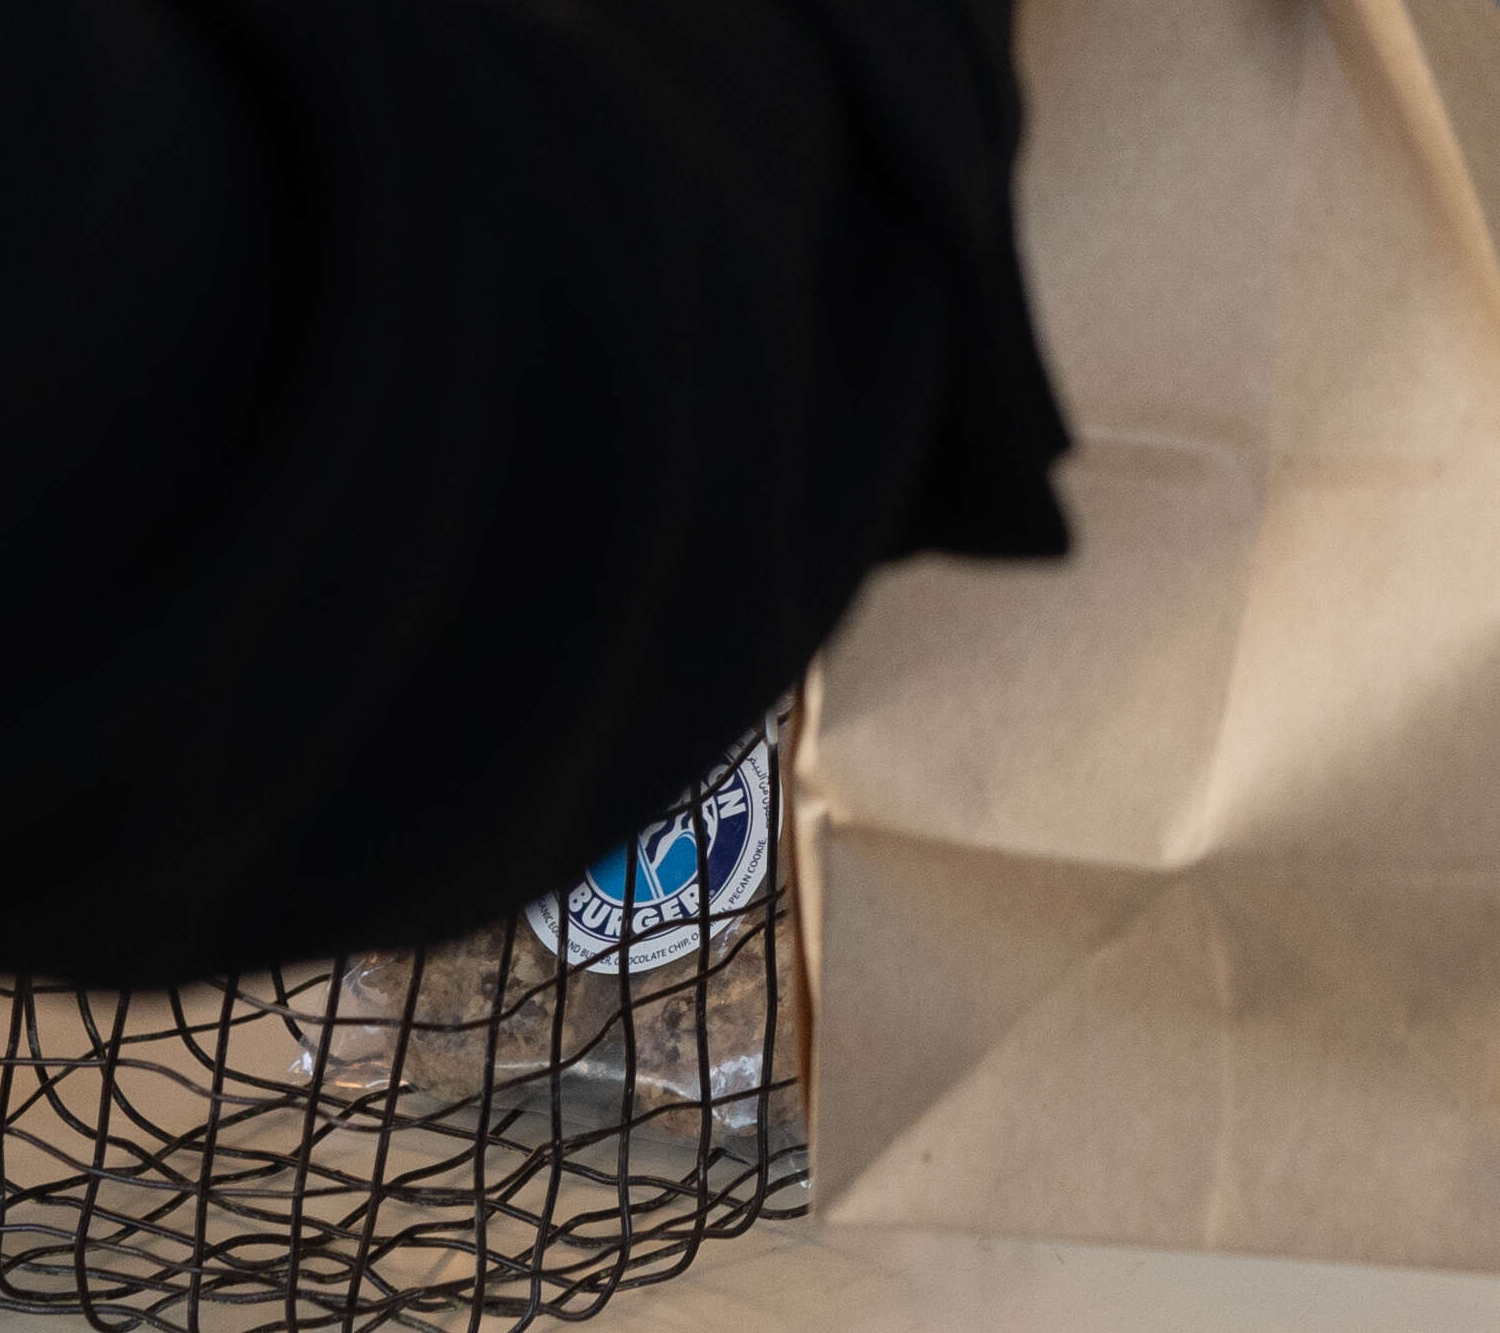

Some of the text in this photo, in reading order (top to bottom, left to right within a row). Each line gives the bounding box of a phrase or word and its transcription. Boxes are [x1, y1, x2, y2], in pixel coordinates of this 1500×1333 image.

[614, 948, 667, 966] COCOLATE
[728, 874, 752, 905] PECAN
[747, 838, 767, 874] COOKIE
